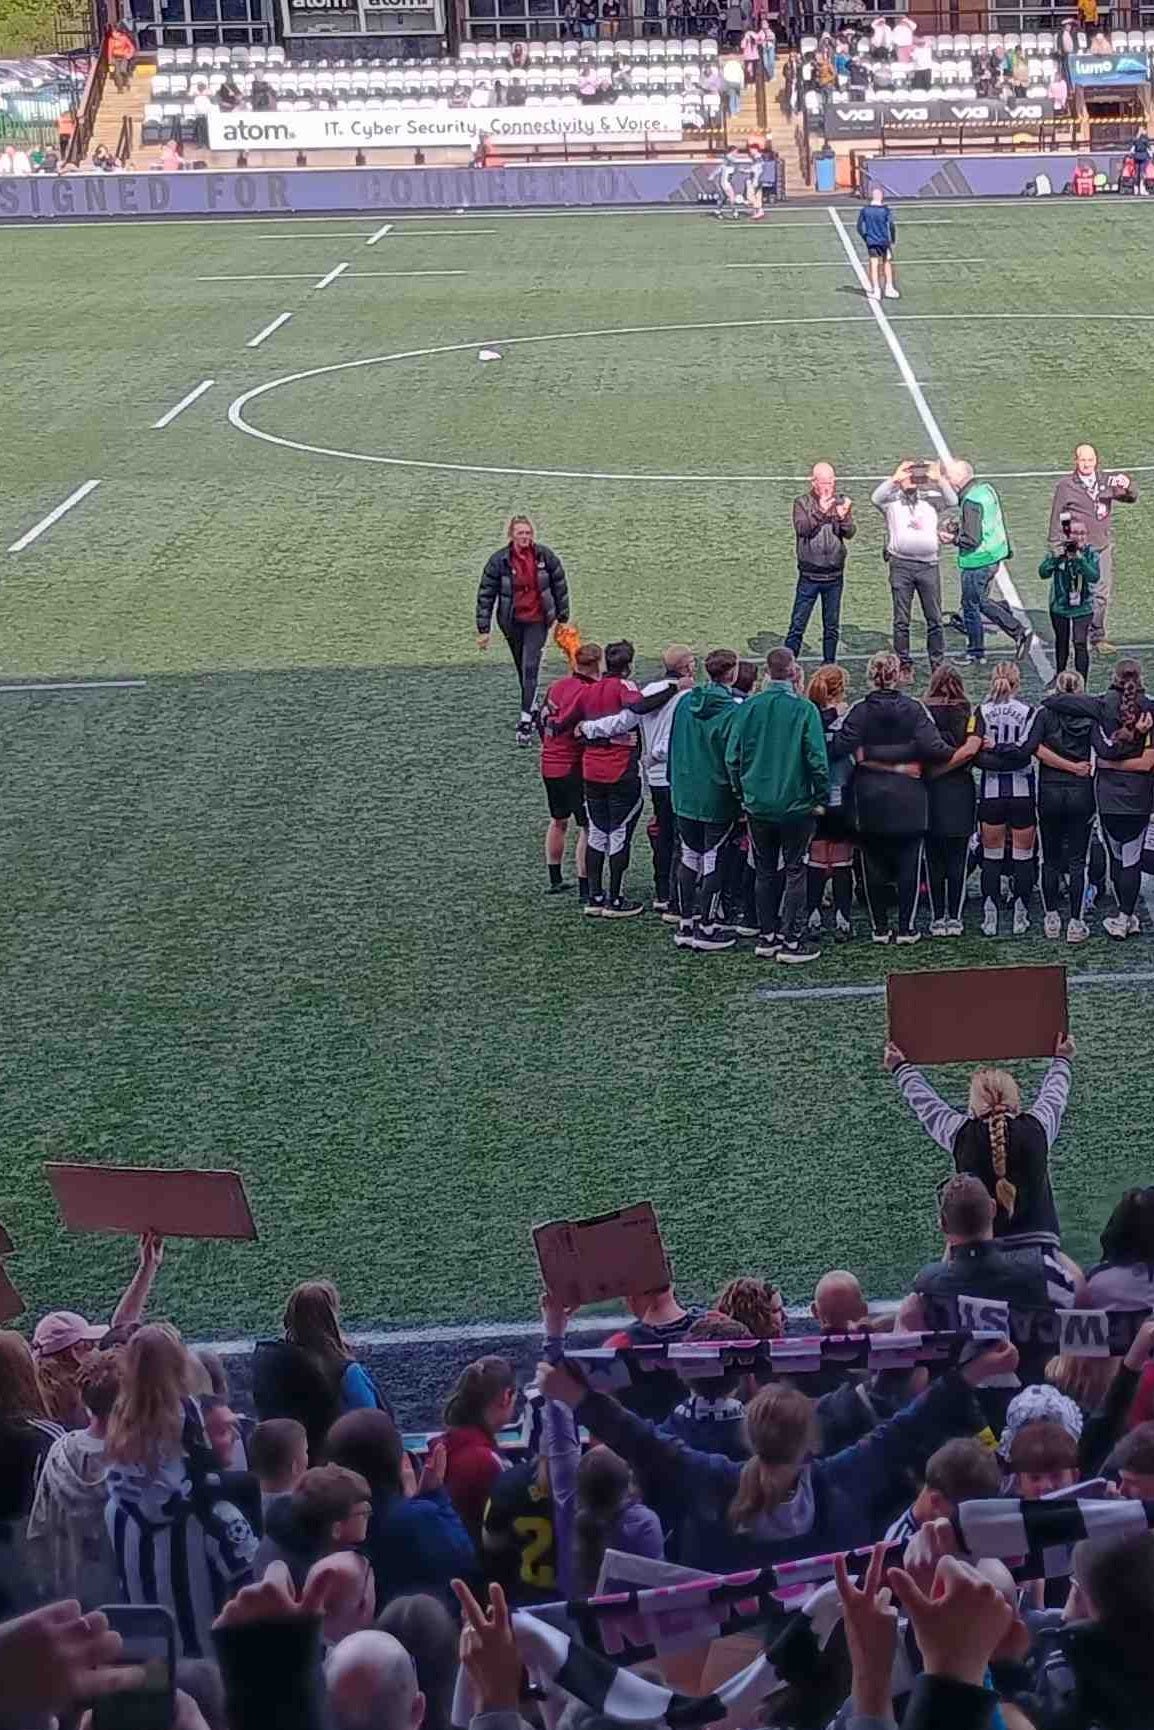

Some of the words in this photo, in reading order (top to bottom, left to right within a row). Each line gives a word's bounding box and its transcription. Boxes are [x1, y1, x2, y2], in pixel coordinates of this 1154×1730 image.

[1075, 61, 1113, 74] lumo
[351, 121, 401, 139] Cyber
[490, 118, 595, 136] Connectivity
[0, 176, 171, 214] SIGNED
[206, 175, 291, 209] FOR
